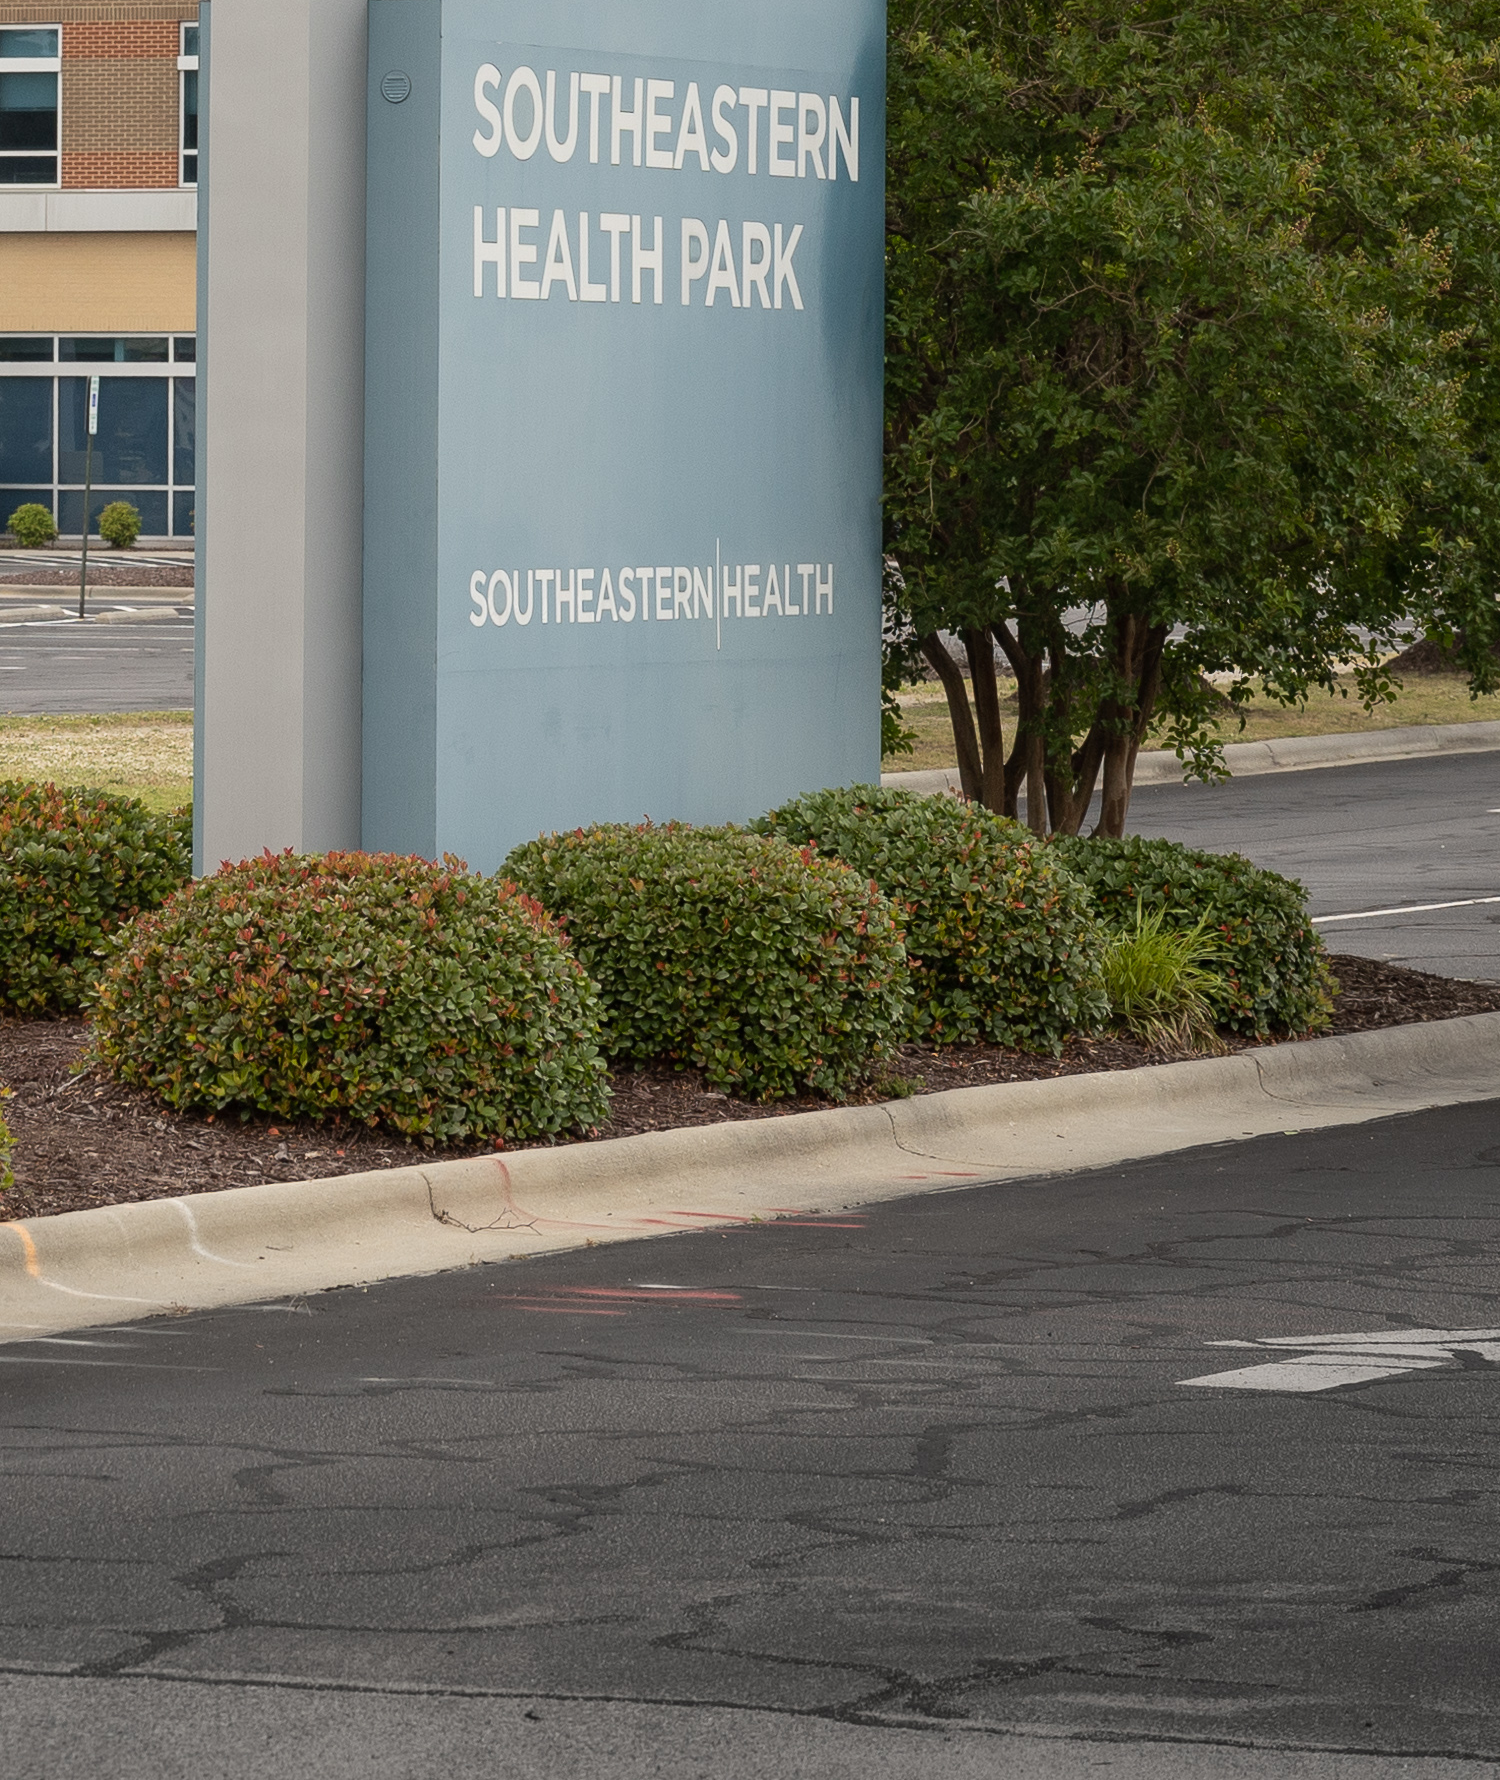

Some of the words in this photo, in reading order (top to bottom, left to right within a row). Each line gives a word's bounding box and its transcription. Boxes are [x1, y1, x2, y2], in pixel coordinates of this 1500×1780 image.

[471, 62, 860, 183] SOUTHEASTERN
[472, 204, 664, 305] HEALTH
[680, 216, 805, 311] PARK
[468, 565, 715, 628] SOUTHEASTERN
[721, 562, 834, 619] HEALTH
